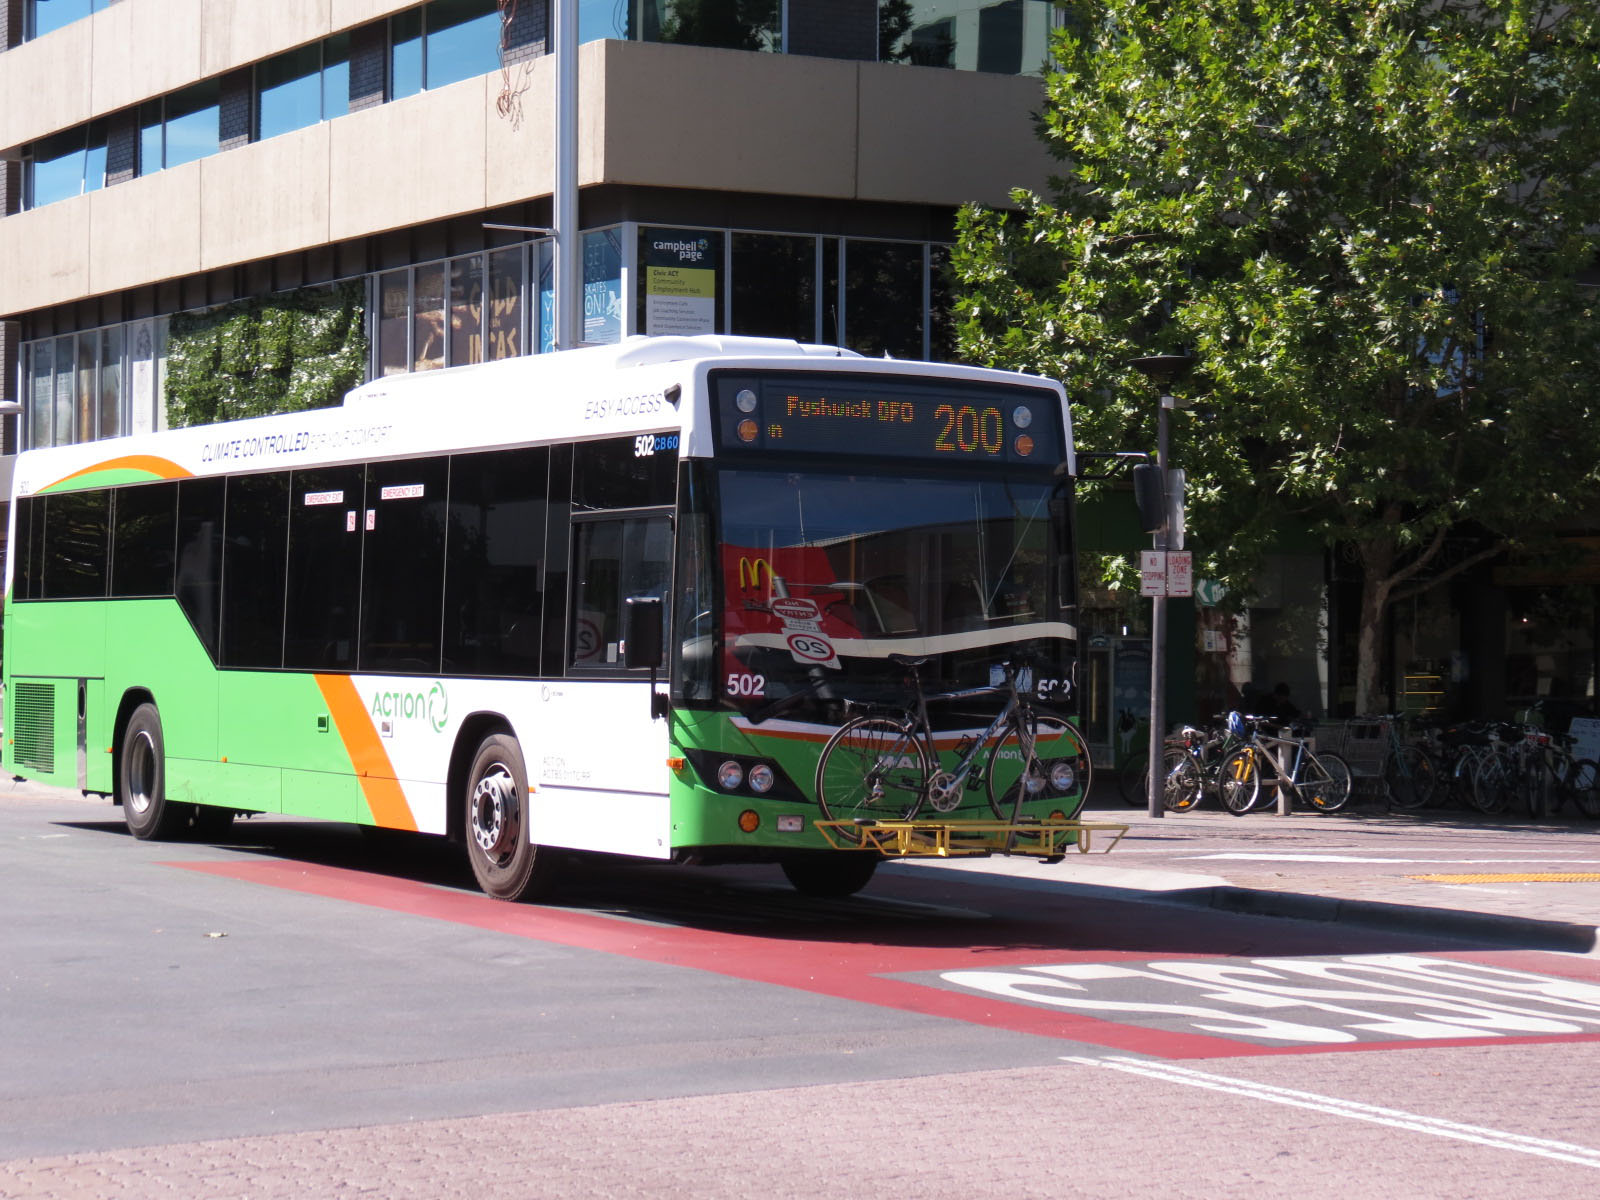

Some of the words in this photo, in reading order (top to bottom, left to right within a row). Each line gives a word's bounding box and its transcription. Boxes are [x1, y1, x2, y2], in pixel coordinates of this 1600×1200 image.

[653, 240, 697, 253] campbell
[679, 250, 703, 262] page
[584, 281, 607, 295] SKATES
[584, 294, 606, 316] ON!
[584, 400, 614, 420] EASY
[615, 393, 662, 416] ACCESS
[787, 396, 871, 417] Fyshwick
[878, 401, 914, 423] DFO
[934, 404, 1003, 454] 200
[202, 440, 241, 463] CLIMATE
[242, 431, 309, 459] CONTROLLED
[634, 434, 655, 457] 502
[383, 487, 411, 499] EMERGENCY
[1150, 557, 1157, 567] NO
[727, 673, 765, 696] 502
[371, 692, 426, 720] ACTION
